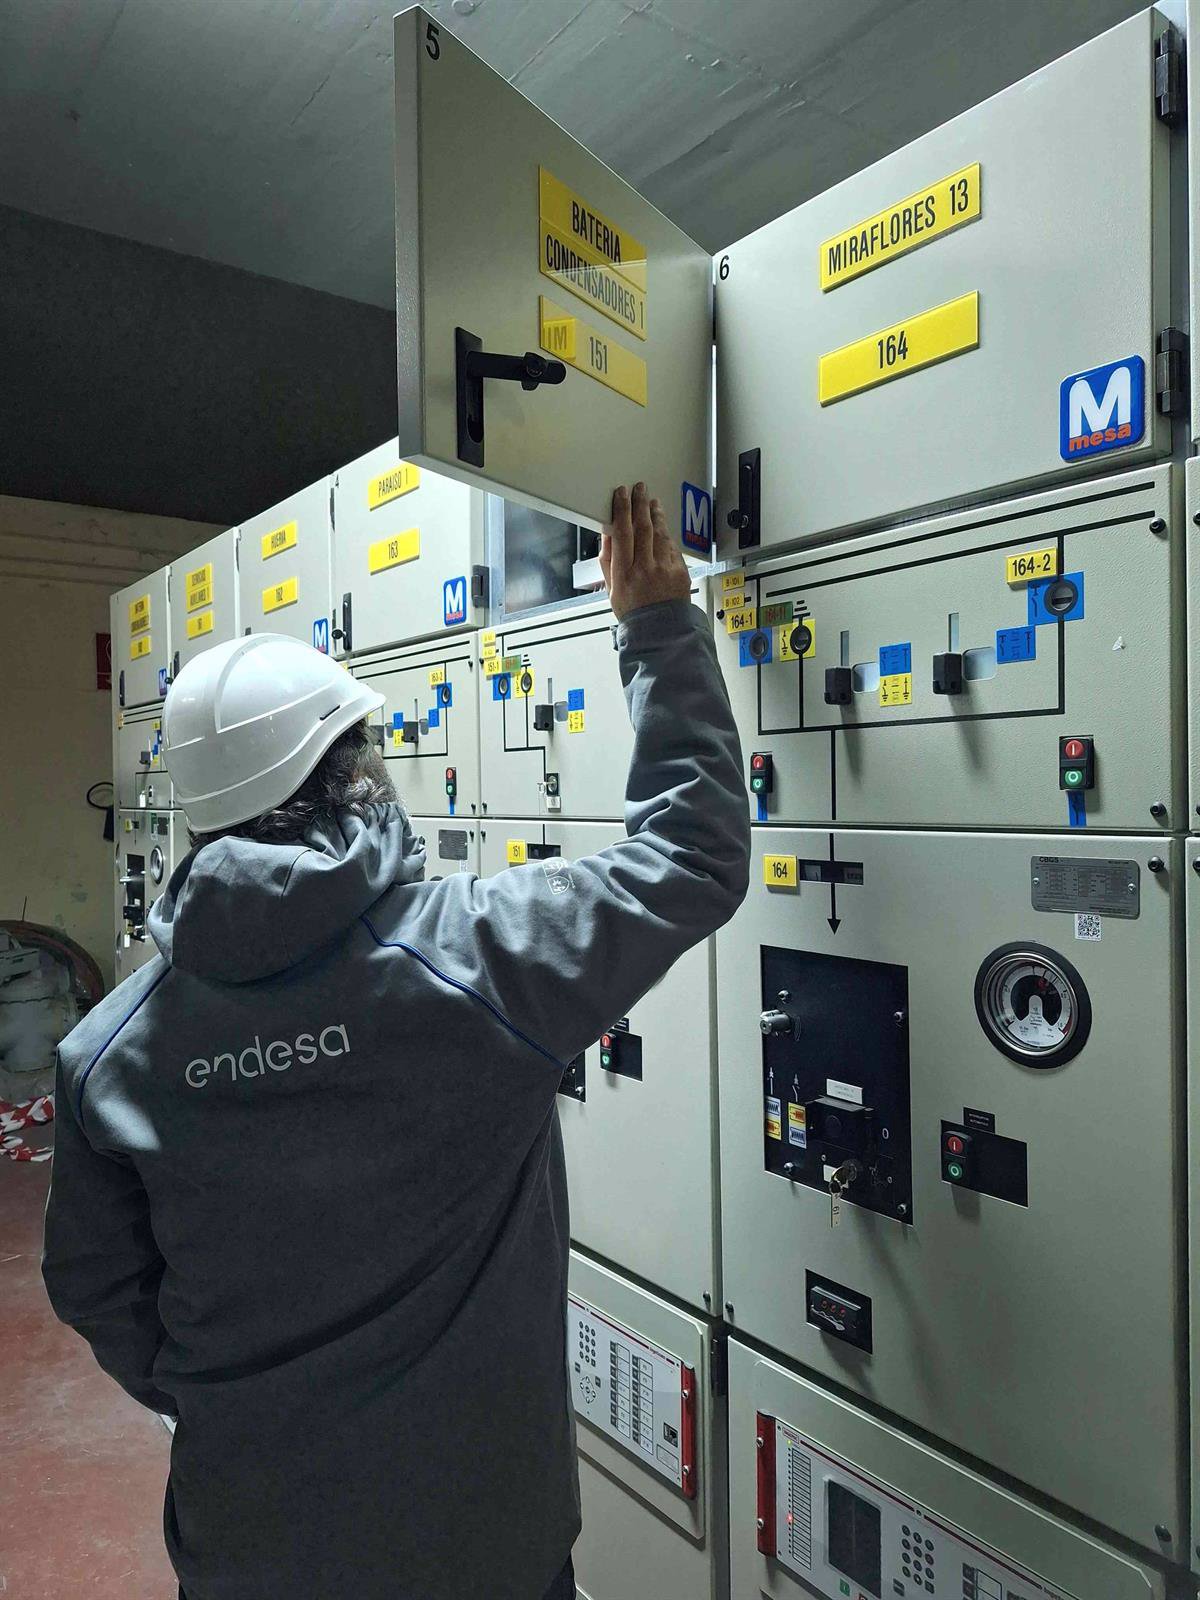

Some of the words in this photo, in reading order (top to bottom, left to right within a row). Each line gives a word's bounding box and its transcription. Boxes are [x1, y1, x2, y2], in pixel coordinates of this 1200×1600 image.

[426, 22, 440, 61] 5
[572, 200, 622, 266] BATERIA
[829, 195, 936, 275] MIRAFLORES
[949, 178, 969, 216] 13
[546, 234, 635, 324] CONDENSADORES
[720, 255, 729, 280] 6
[590, 336, 607, 374] 151
[878, 330, 908, 369] 164
[1069, 366, 1131, 438] M
[1069, 422, 1131, 452] mesa
[388, 540, 399, 561] 163
[1012, 553, 1051, 577] 164-2
[731, 612, 753, 629] 164-1
[772, 861, 788, 878] 164
[185, 1023, 351, 1088] endesa
